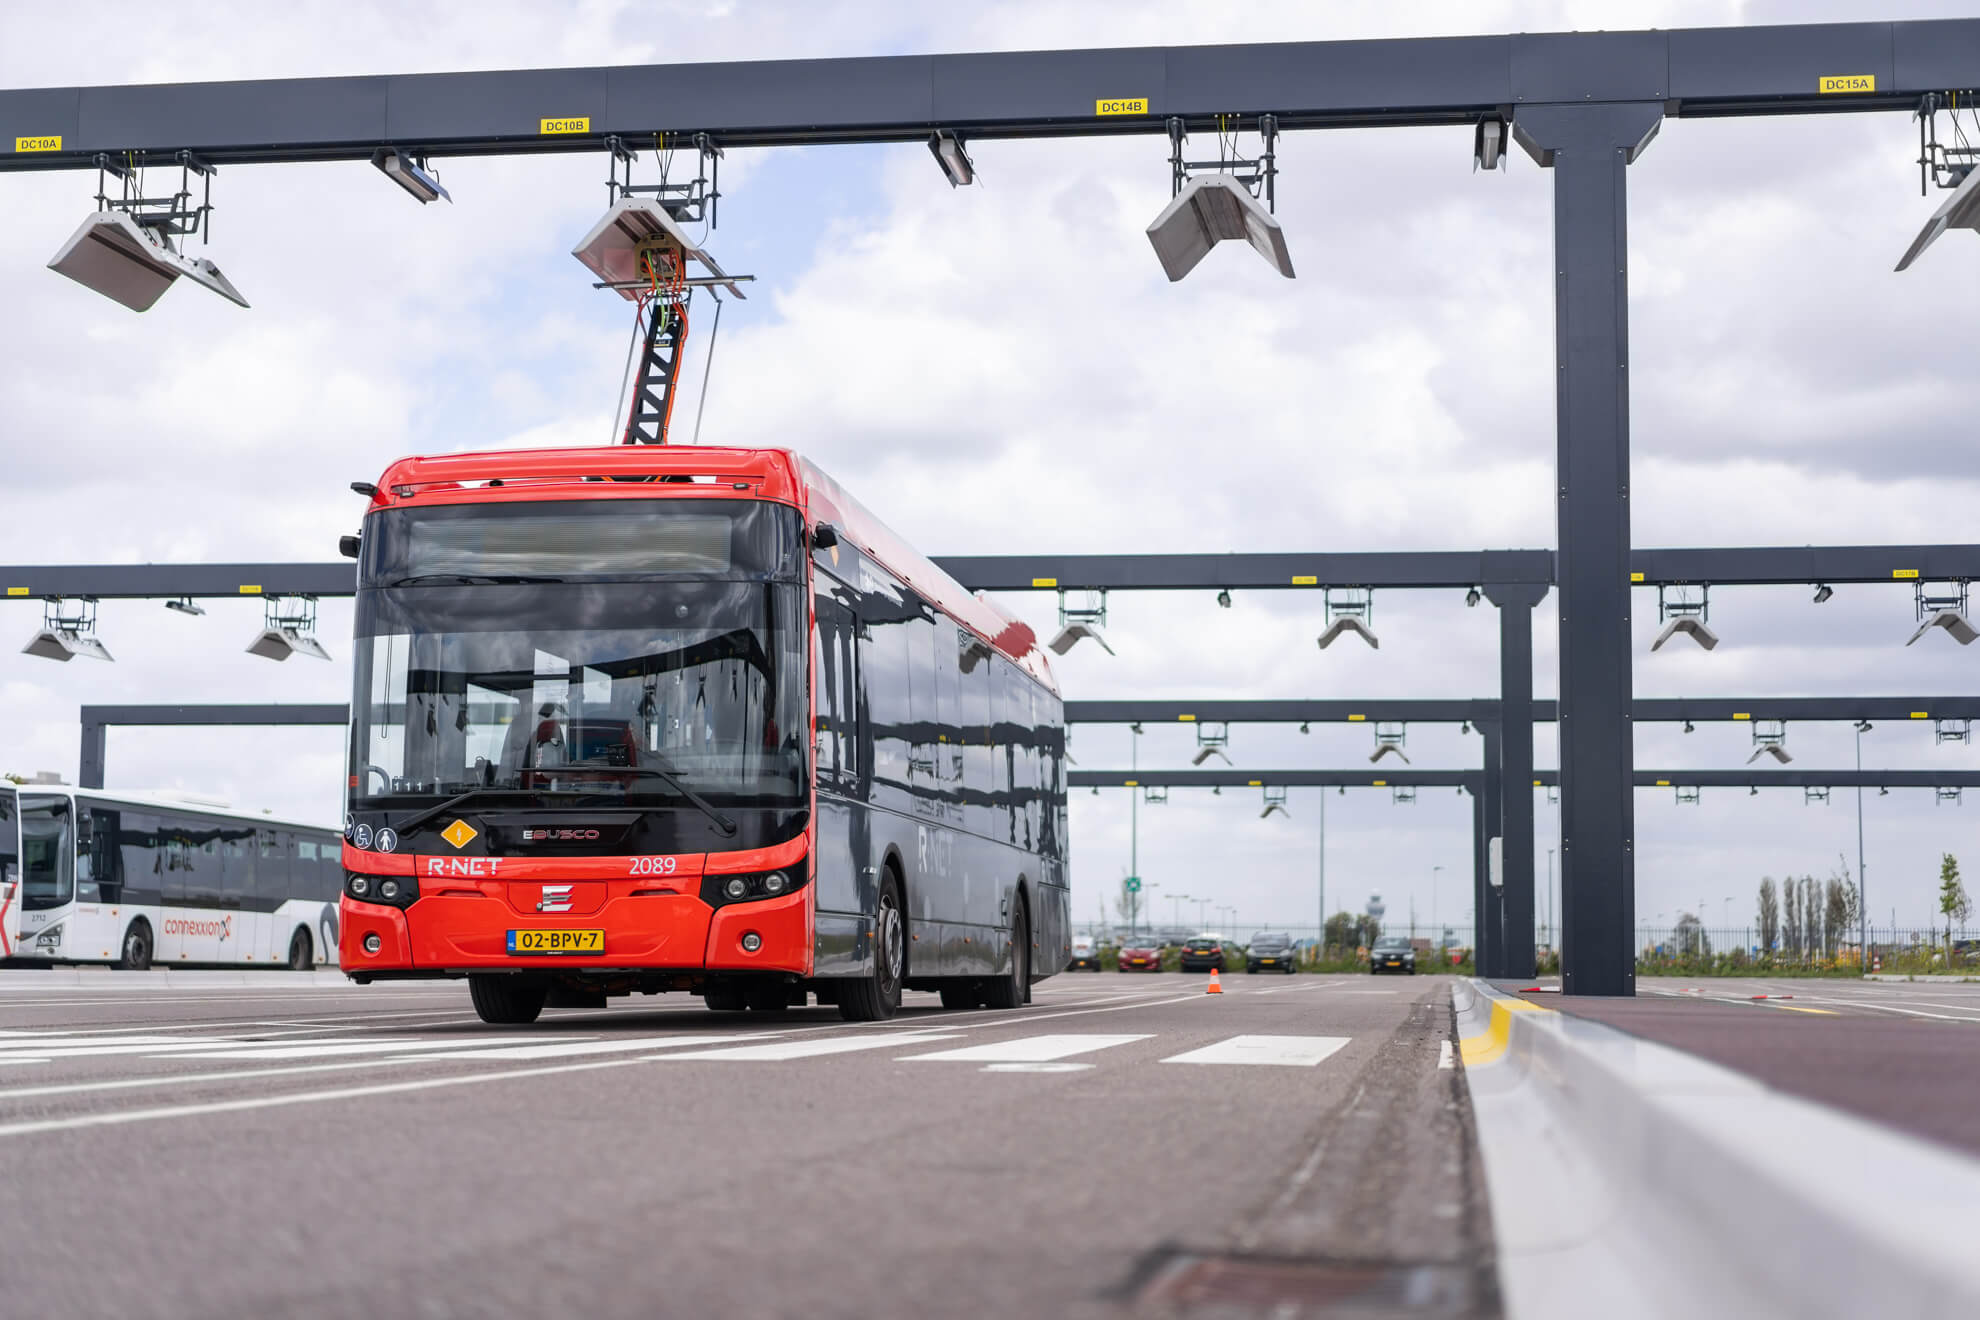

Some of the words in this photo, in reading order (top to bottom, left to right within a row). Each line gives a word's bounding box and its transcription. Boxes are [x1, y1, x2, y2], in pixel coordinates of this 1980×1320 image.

[1826, 79, 1869, 90] DC15A
[1102, 101, 1142, 112] DC14B
[546, 120, 584, 131] DC10B
[21, 139, 57, 149] DC10A
[522, 829, 600, 840] EBUSCO
[629, 857, 676, 874] 2089
[164, 918, 221, 937] connexxion
[522, 933, 598, 948] 02-BPV-7
